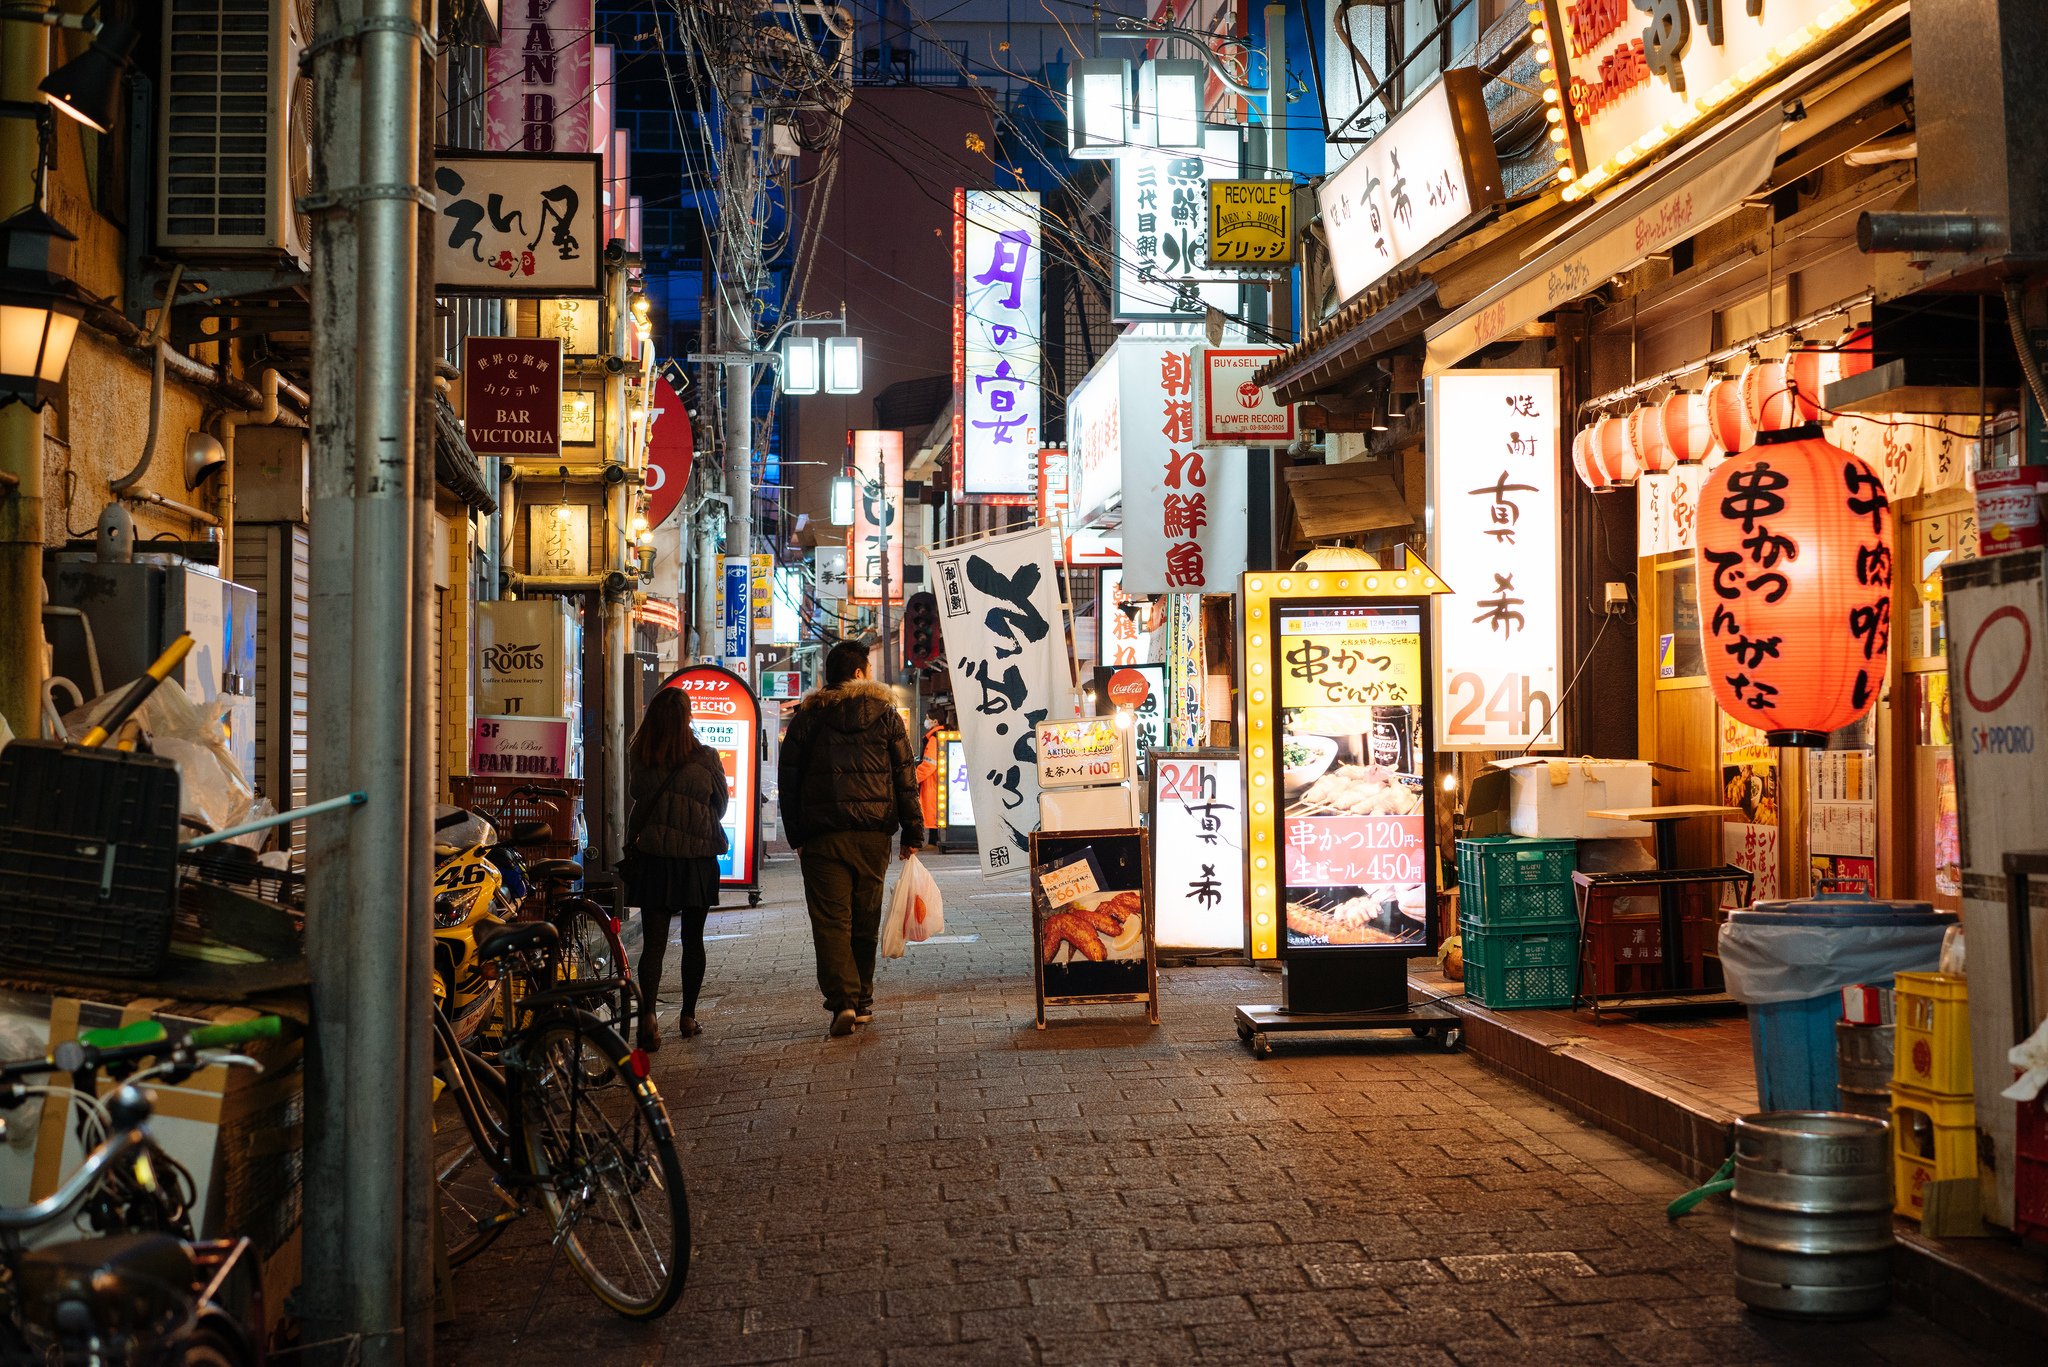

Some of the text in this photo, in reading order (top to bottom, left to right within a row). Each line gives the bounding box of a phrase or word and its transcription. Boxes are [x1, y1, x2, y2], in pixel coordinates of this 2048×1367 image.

[1225, 187, 1277, 204] RECYCLE
[435, 166, 580, 262] えん屋
[1221, 211, 1280, 226] MEN'S BOOK
[1217, 241, 1286, 259] ブリッジ
[972, 229, 1032, 445] 月の宴
[478, 353, 550, 373] 世界の銘酒
[508, 368, 518, 379] &
[484, 383, 540, 397] カクテル
[496, 409, 530, 423] BAR
[1215, 414, 1285, 424] FLOWER RECORD
[1505, 394, 1540, 457] 焼酎
[471, 429, 554, 444] VICTORIA
[1161, 351, 1207, 588] 朝獲れ鮮魚
[1721, 462, 1796, 603] 串かつ
[1704, 547, 1783, 711] でんがな
[726, 625, 738, 656] 眼科
[482, 648, 544, 675] Roots
[1286, 639, 1391, 684] 串かつ
[523, 677, 543, 685] Factory
[682, 679, 730, 691] カラオケ
[1319, 678, 1408, 704] でんがな
[502, 697, 523, 715] JT
[702, 701, 736, 713] ECHO
[1448, 672, 1552, 735] 24h
[480, 723, 500, 738] 3F
[495, 738, 543, 751] Girls Bar
[477, 753, 562, 775] FAN DOLL
[1159, 763, 1217, 801] 24h
[435, 863, 486, 889] 46
